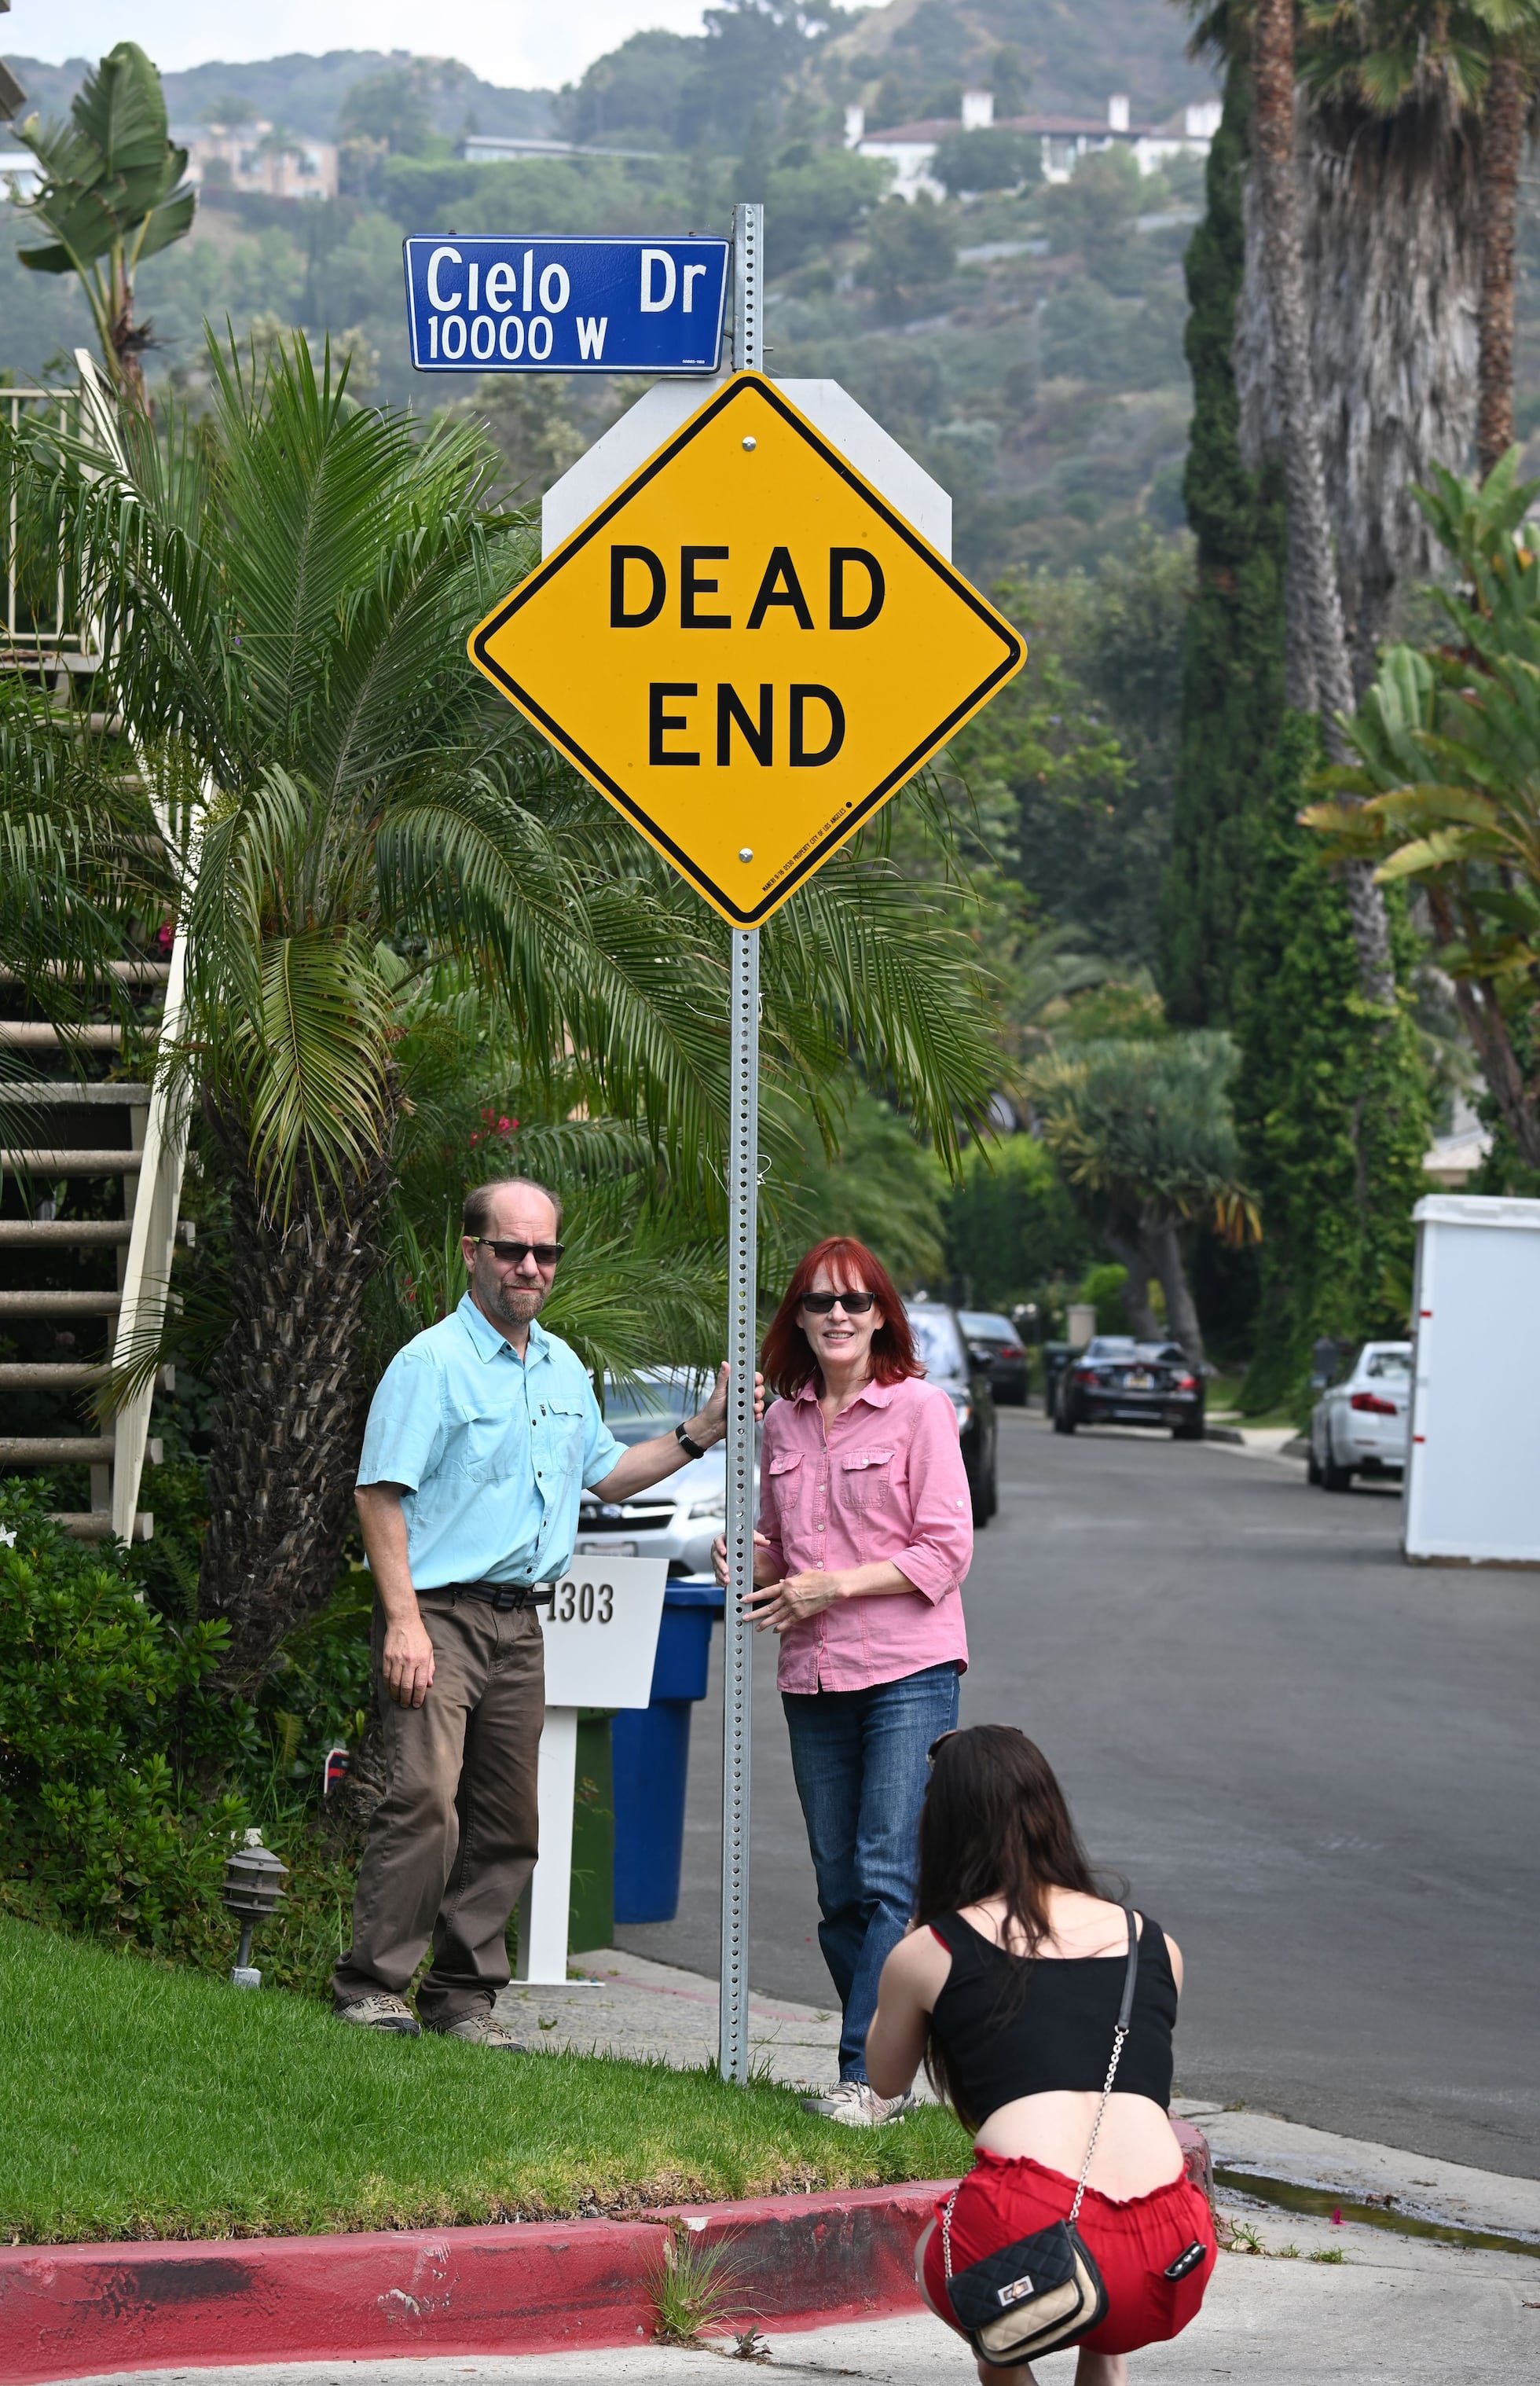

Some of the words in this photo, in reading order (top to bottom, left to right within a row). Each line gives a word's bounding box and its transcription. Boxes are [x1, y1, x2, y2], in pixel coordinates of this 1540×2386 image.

[427, 246, 570, 314] Cielo
[640, 248, 707, 313] Dr
[427, 314, 553, 360] 10000
[576, 317, 608, 360] W
[610, 545, 886, 630] DEAD
[649, 682, 845, 767] END
[792, 842, 811, 861] PROPERTY
[809, 835, 819, 845] CITY
[823, 822, 831, 831] LOS
[830, 807, 846, 824] ANGELES
[547, 1581, 614, 1624] 1303
